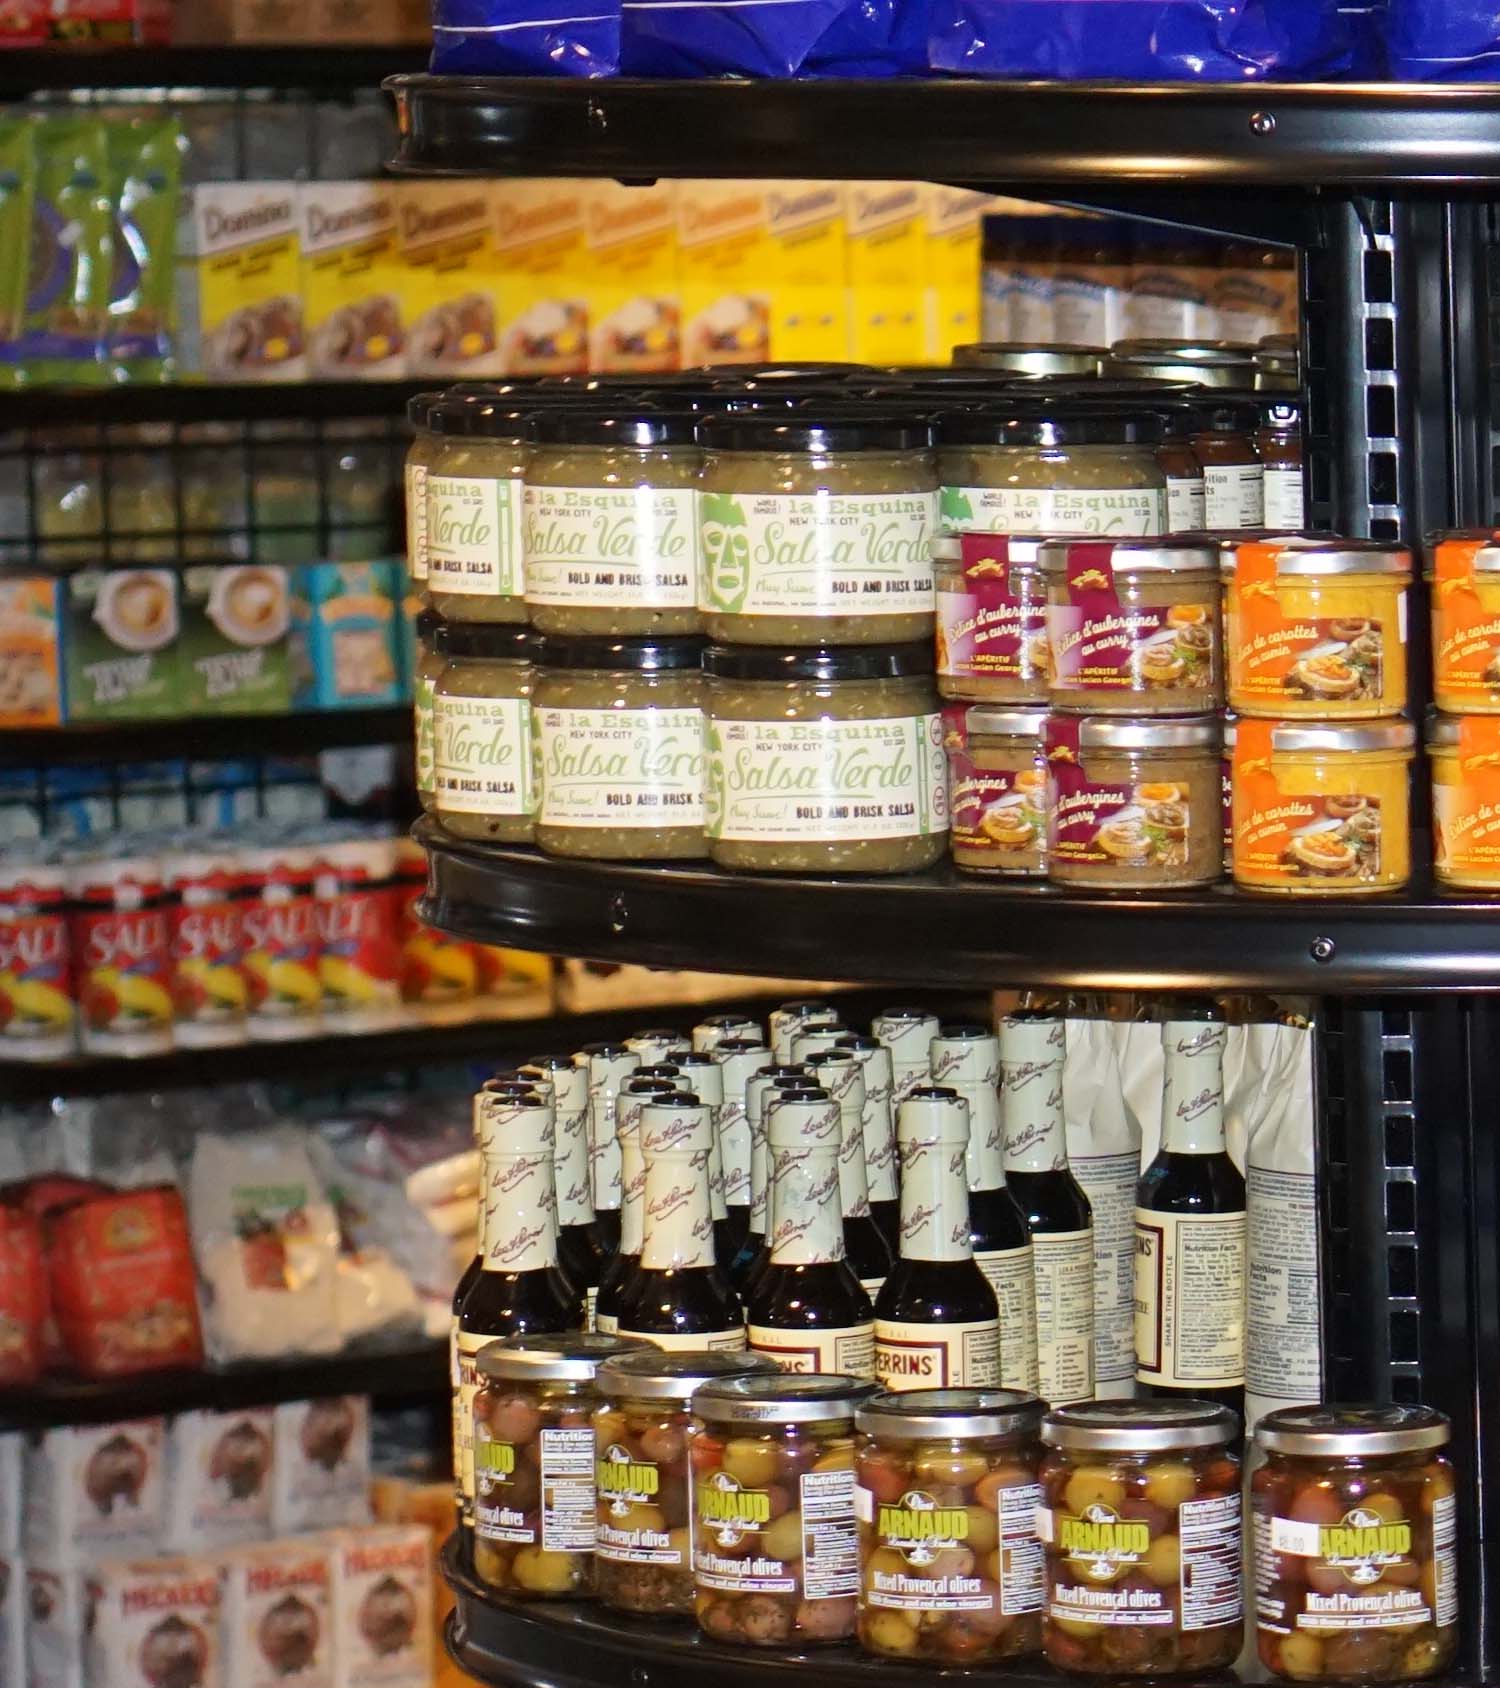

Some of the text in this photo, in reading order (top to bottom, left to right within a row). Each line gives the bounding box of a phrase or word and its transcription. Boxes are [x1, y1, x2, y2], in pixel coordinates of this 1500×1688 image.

[755, 724, 905, 743] la Esquina
[756, 742, 823, 751] NEW YORK CITY
[727, 749, 912, 792] Salsa Verde
[797, 803, 915, 820] BOLD AND BRISK SALSA
[1479, 806, 1492, 821] de
[879, 1509, 969, 1538] ARNAUD
[874, 1572, 981, 1596] Mixed Provençal olives
